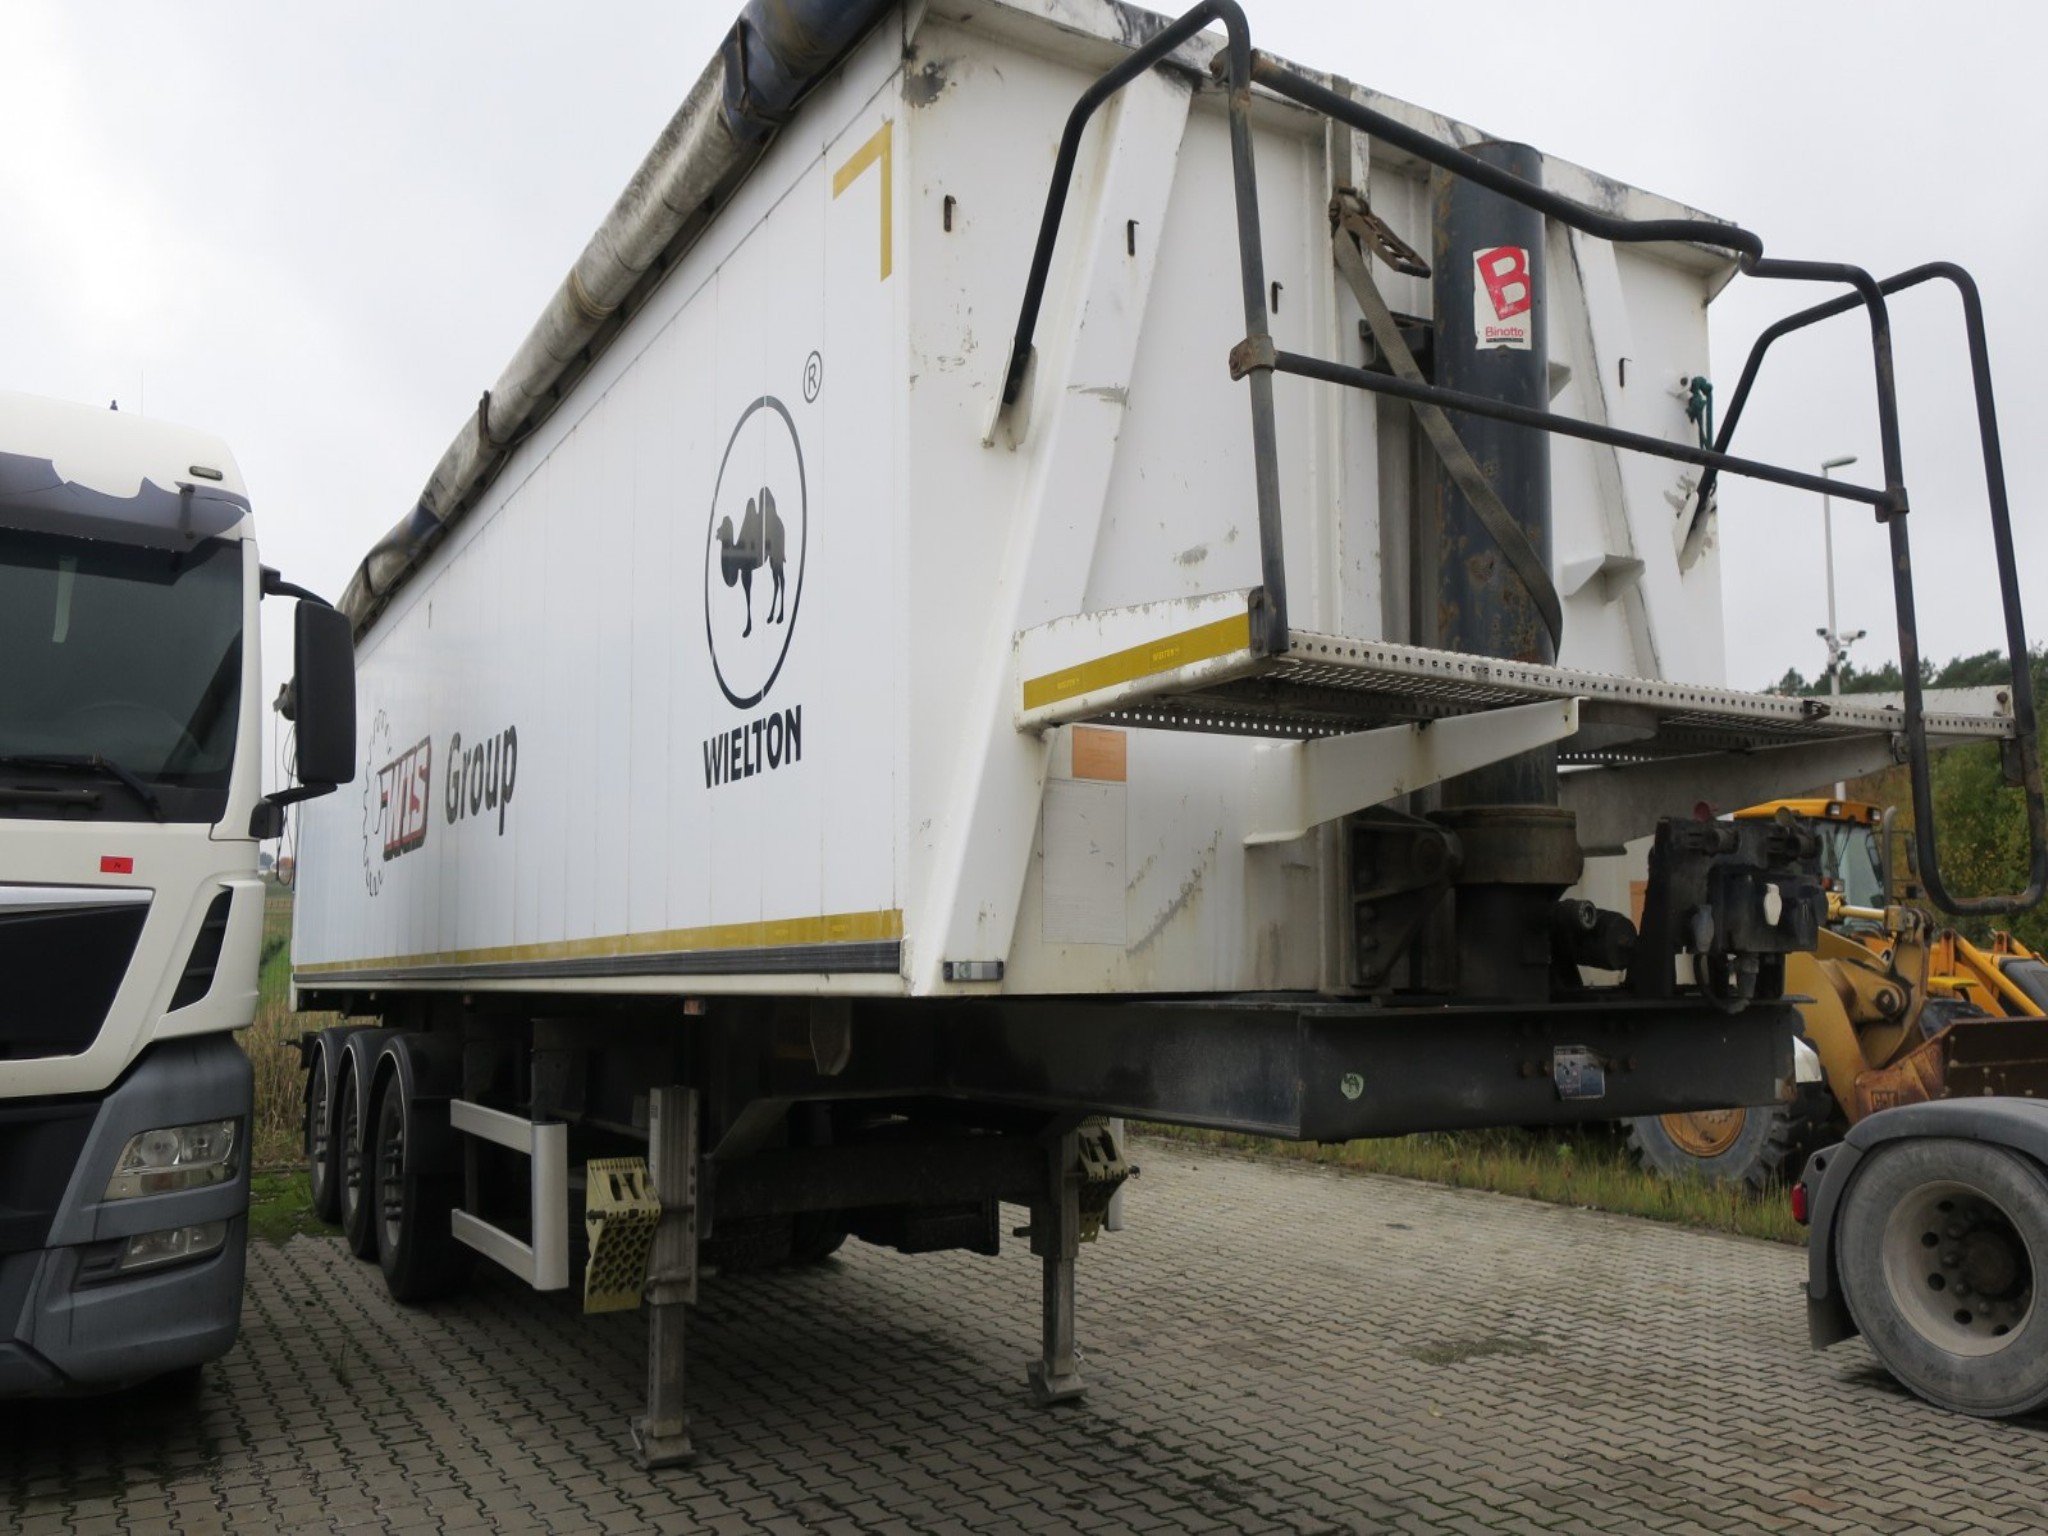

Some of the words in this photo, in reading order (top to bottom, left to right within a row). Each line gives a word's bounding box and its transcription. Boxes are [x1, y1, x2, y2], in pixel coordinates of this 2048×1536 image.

[1477, 246, 1531, 321] B
[1485, 326, 1524, 337] Binotto
[445, 724, 518, 836] Group
[703, 704, 802, 789] WIELTON
